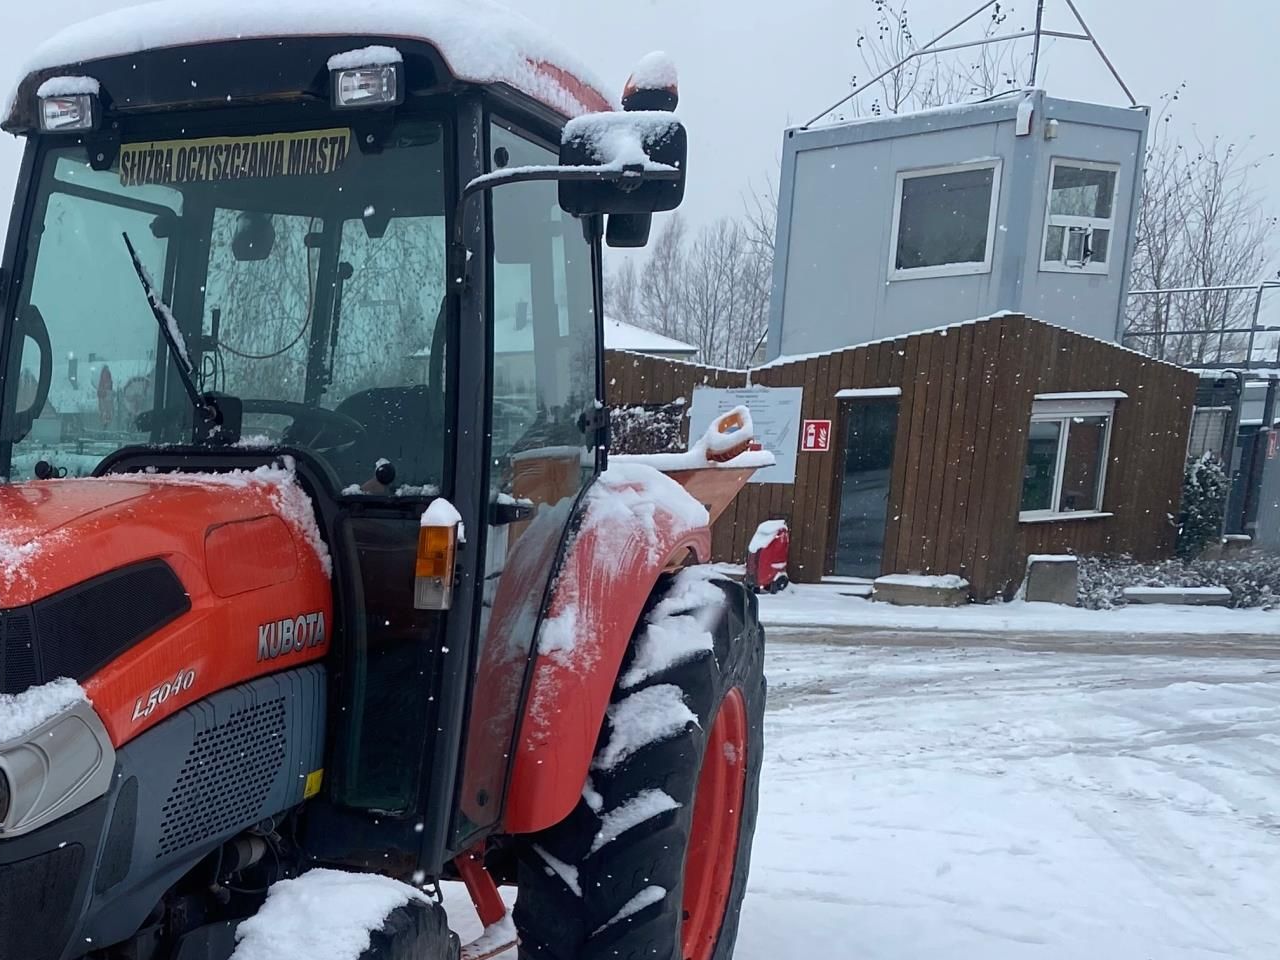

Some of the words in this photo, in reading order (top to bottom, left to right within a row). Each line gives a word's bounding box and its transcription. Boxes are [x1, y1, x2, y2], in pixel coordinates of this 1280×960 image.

[175, 138, 286, 183] OCZYSZCZANIA
[287, 135, 347, 176] MIASTA
[257, 612, 326, 662] KUBOTA
[131, 668, 196, 722] L5040
